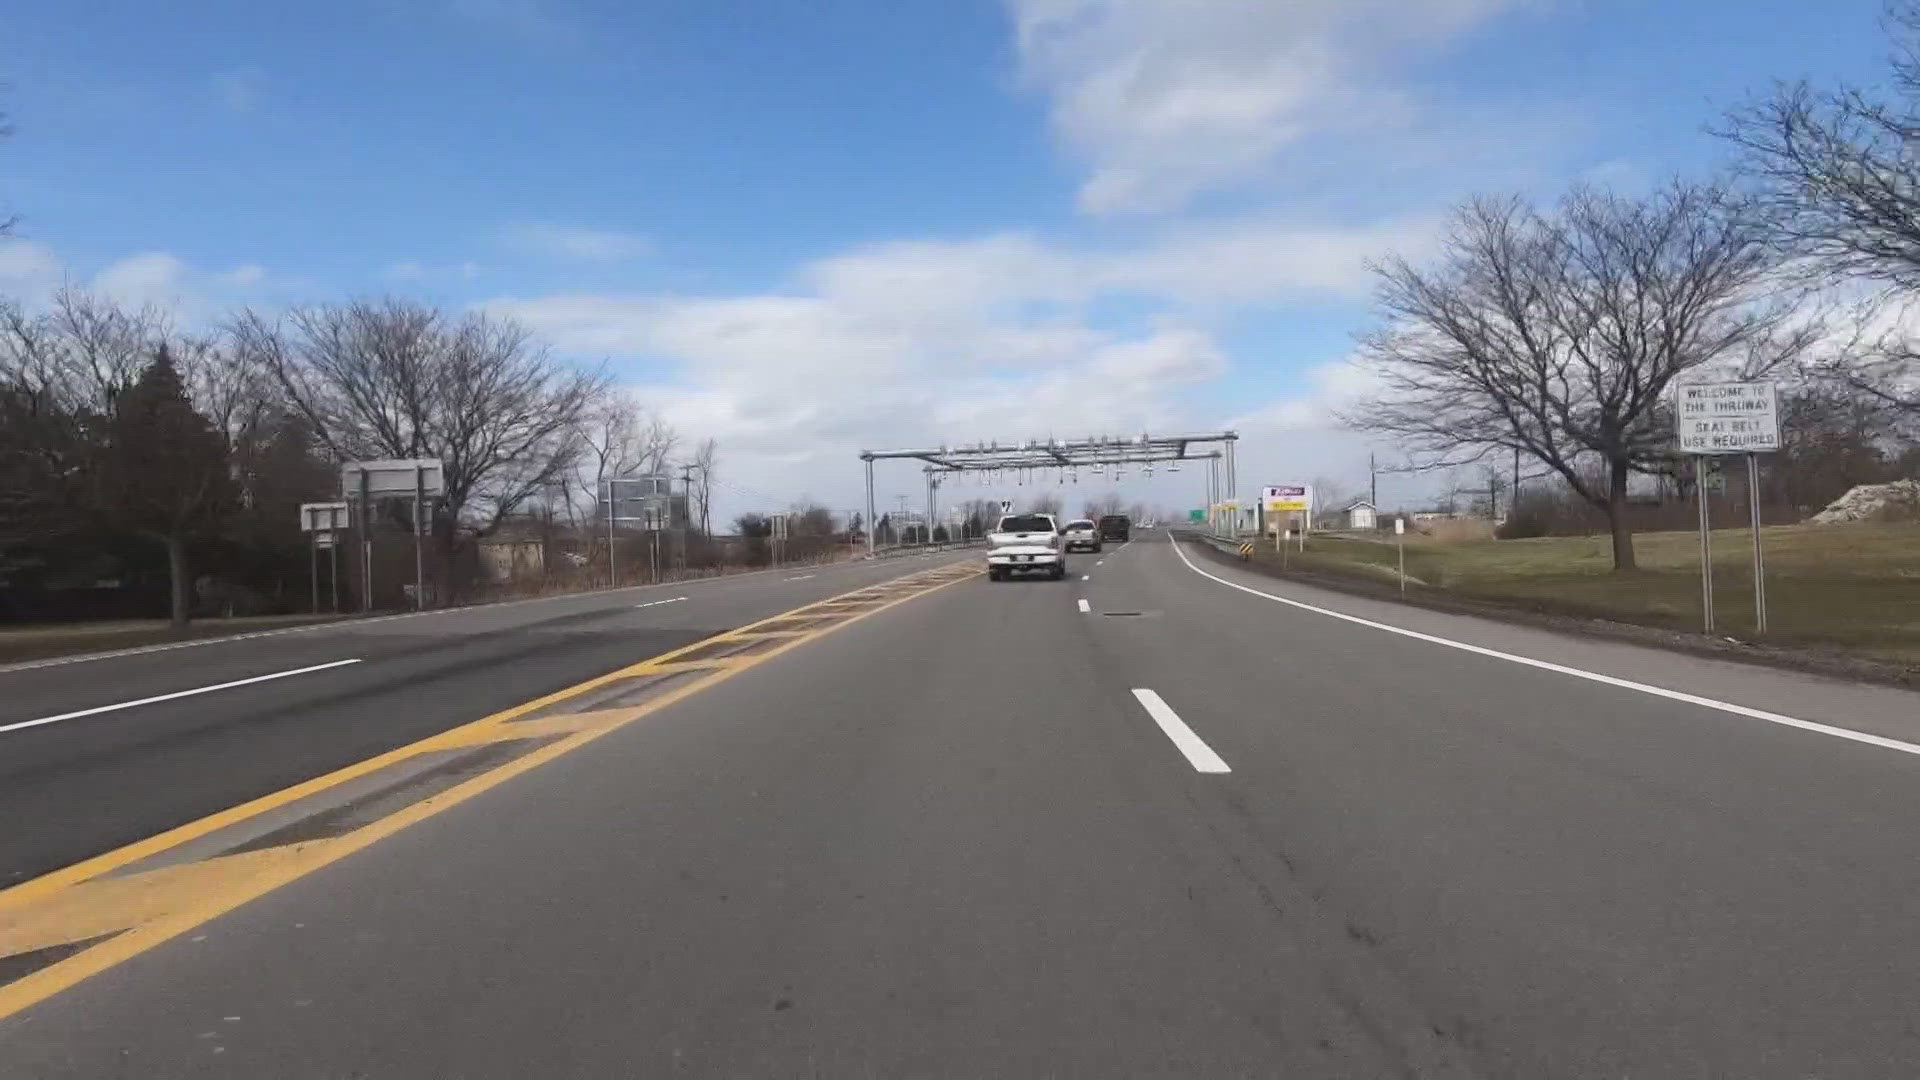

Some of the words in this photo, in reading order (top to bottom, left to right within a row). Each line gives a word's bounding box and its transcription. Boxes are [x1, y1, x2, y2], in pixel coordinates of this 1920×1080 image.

[1687, 387, 1745, 398] WELCOME
[1753, 387, 1765, 396] TO
[1685, 402, 1705, 412] THE
[1714, 400, 1769, 412] THRUWAY
[1695, 422, 1724, 432] SEAT
[1731, 421, 1760, 432] BELT
[1683, 437, 1705, 447] USE
[1713, 434, 1775, 447] REQUIRED
